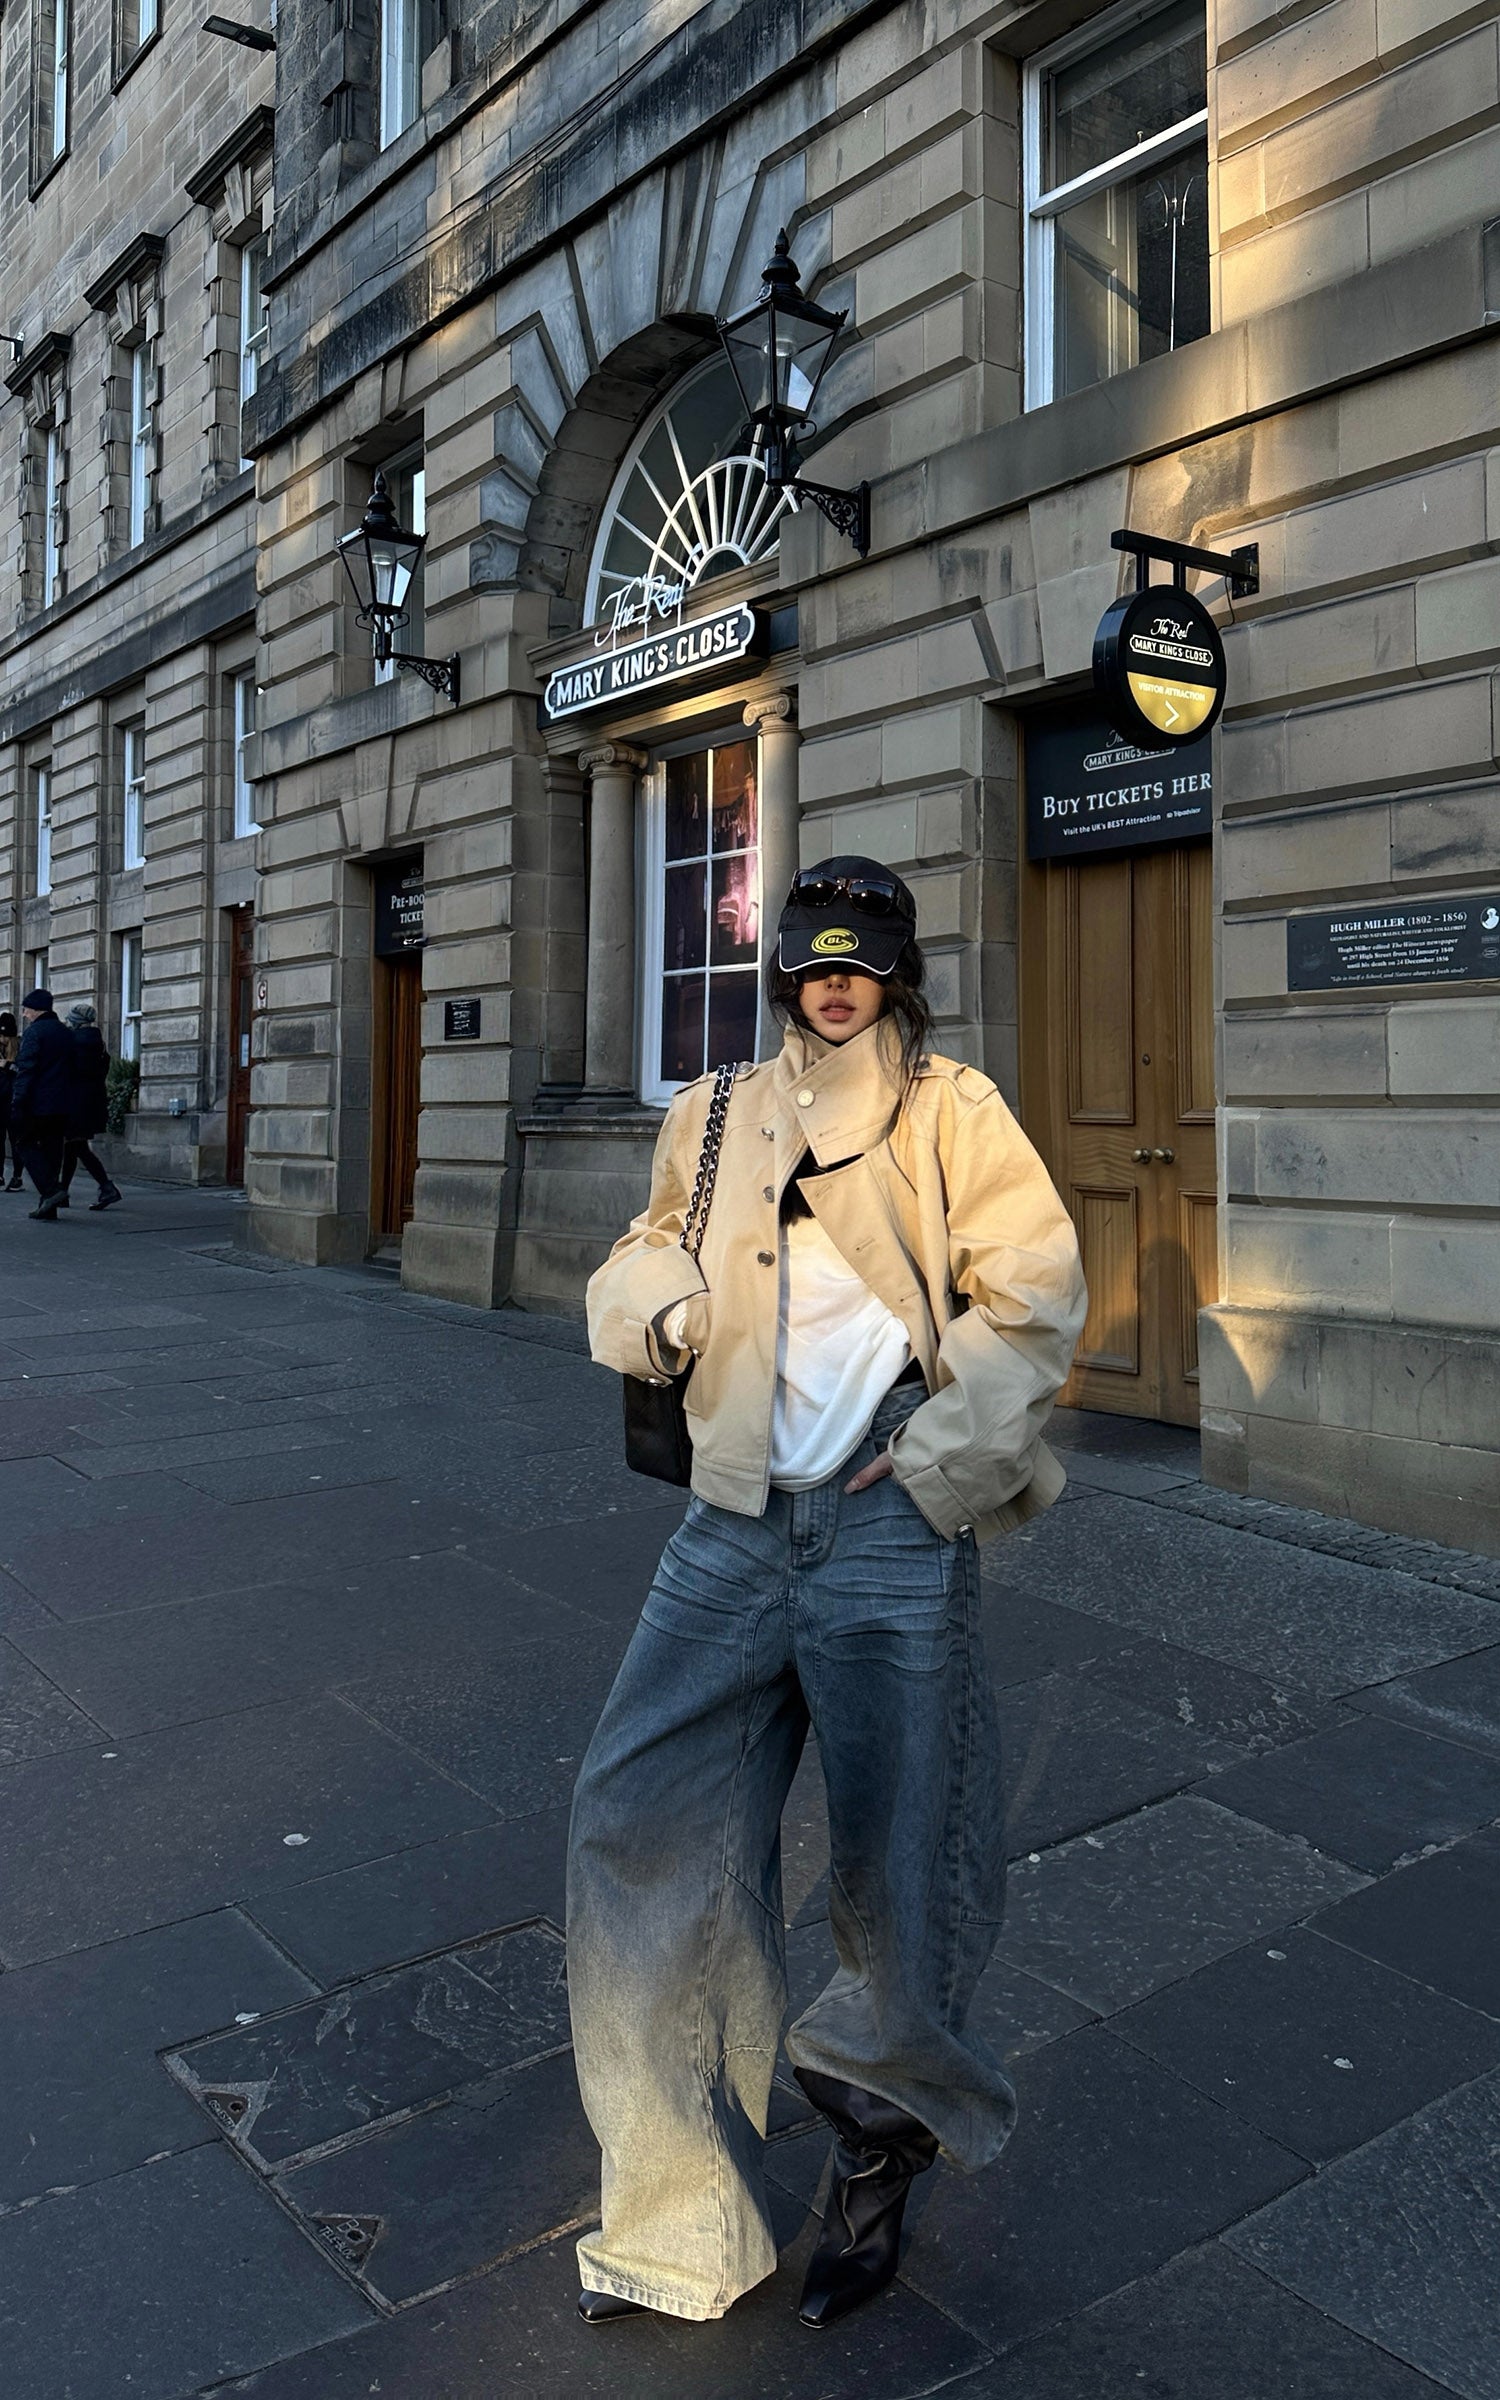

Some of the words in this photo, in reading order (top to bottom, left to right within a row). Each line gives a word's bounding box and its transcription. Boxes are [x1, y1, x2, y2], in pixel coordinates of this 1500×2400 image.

[595, 577, 642, 647] The
[1150, 618, 1170, 636] The
[1169, 621, 1194, 640] Real
[1135, 638, 1157, 652] MARY
[1185, 649, 1209, 663] CLOSE
[557, 665, 604, 707] MARY
[611, 643, 669, 689] KING'S
[676, 617, 740, 666] CLOSE
[1138, 681, 1164, 694] VISITOR
[1165, 686, 1206, 702] ATTRACTION
[1088, 755, 1112, 768] MARY
[1086, 782, 1164, 811] TICKETS
[1172, 772, 1212, 796] HER
[1063, 827, 1079, 836] Visit
[1080, 825, 1091, 834] the
[1107, 818, 1125, 829] BEST
[1125, 813, 1162, 826] Attraction
[391, 894, 425, 910] PRE-BOO
[400, 910, 424, 924] TICKET
[1330, 921, 1361, 933] HUGH
[1364, 917, 1405, 930] MILLER
[1407, 915, 1432, 926] (1802
[1442, 911, 1467, 922] 1856)
[1404, 957, 1435, 965] December
[1415, 948, 1439, 956] January
